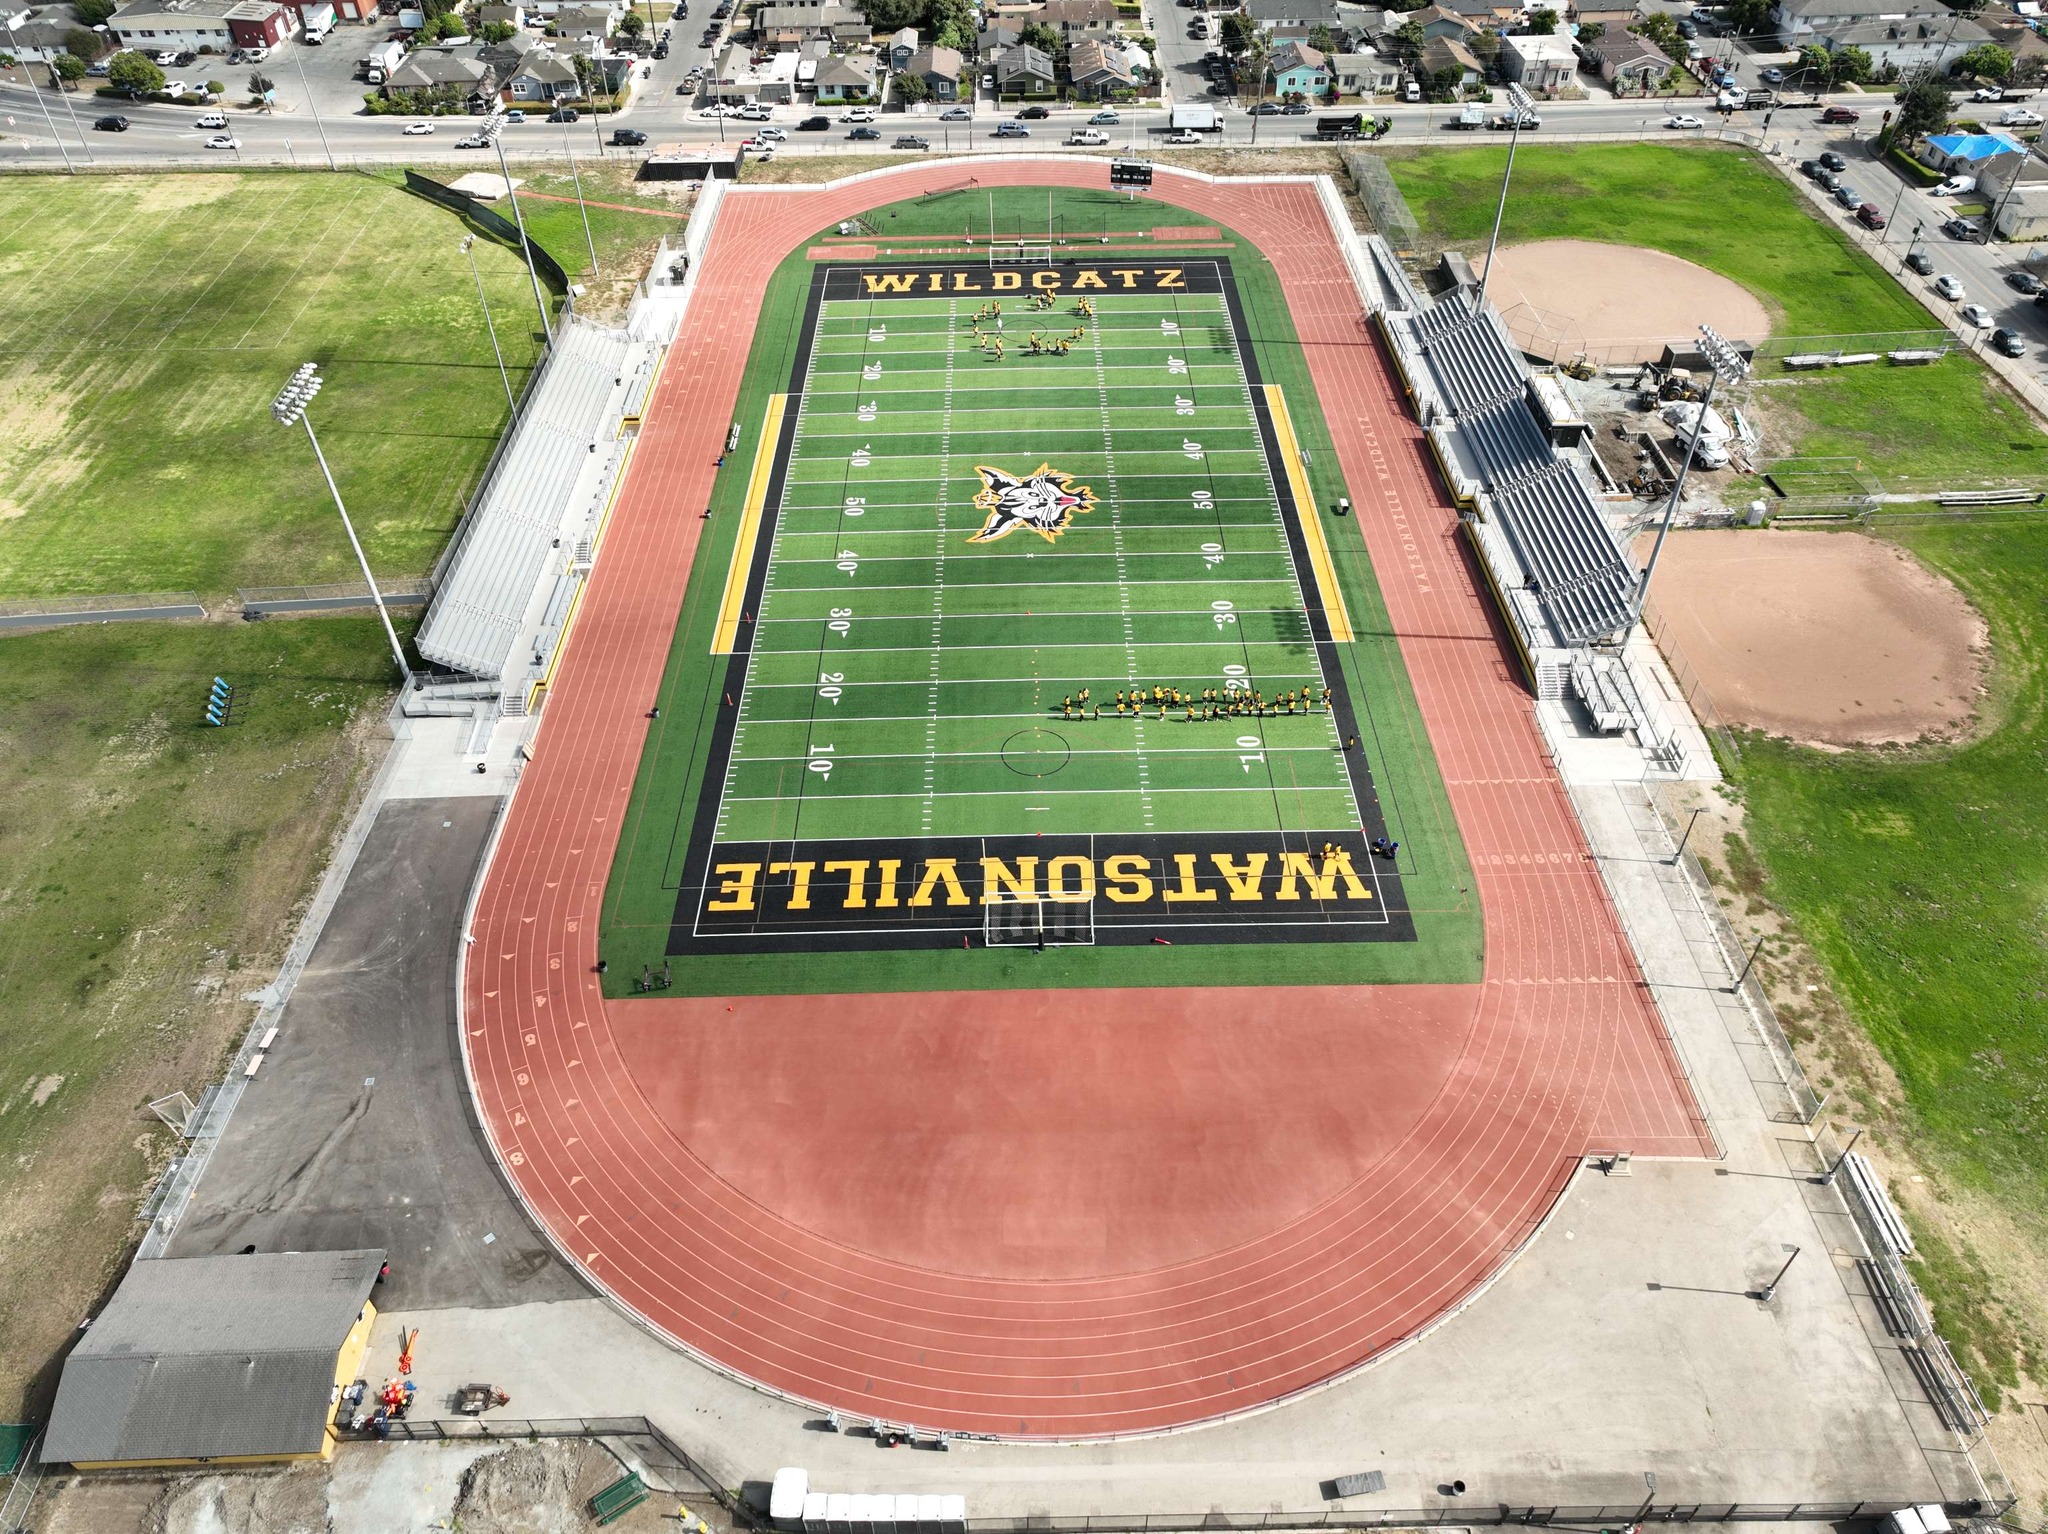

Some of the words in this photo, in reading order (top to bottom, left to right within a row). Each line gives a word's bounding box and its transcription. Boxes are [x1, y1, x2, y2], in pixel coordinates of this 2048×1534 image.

[863, 270, 1184, 292] WILDCATZ
[869, 328, 886, 342] 10
[1161, 322, 1180, 336] 10
[863, 365, 882, 380] 20
[1167, 359, 1187, 374] 20
[858, 405, 877, 421] 30
[1175, 399, 1195, 415] 30
[851, 449, 871, 466] 40
[1182, 443, 1204, 460] 40
[844, 497, 866, 516] 50
[1191, 490, 1213, 509] 50
[837, 550, 859, 570] 40
[1201, 543, 1224, 563] 40
[828, 607, 852, 631] 30
[1211, 600, 1236, 623] 30
[819, 672, 844, 697] 20
[1223, 664, 1250, 690] 20
[808, 744, 835, 772] 10
[1236, 736, 1264, 764] 10
[1477, 855, 1487, 865] 1
[1504, 854, 1516, 864] 3
[1519, 853, 1531, 864] 4
[1534, 853, 1545, 863] 5
[1549, 852, 1560, 863] 6
[1562, 852, 1572, 863] 7
[708, 852, 1373, 911] WATSONVILLE
[535, 995, 547, 1007] 4
[514, 1112, 526, 1126] 7
